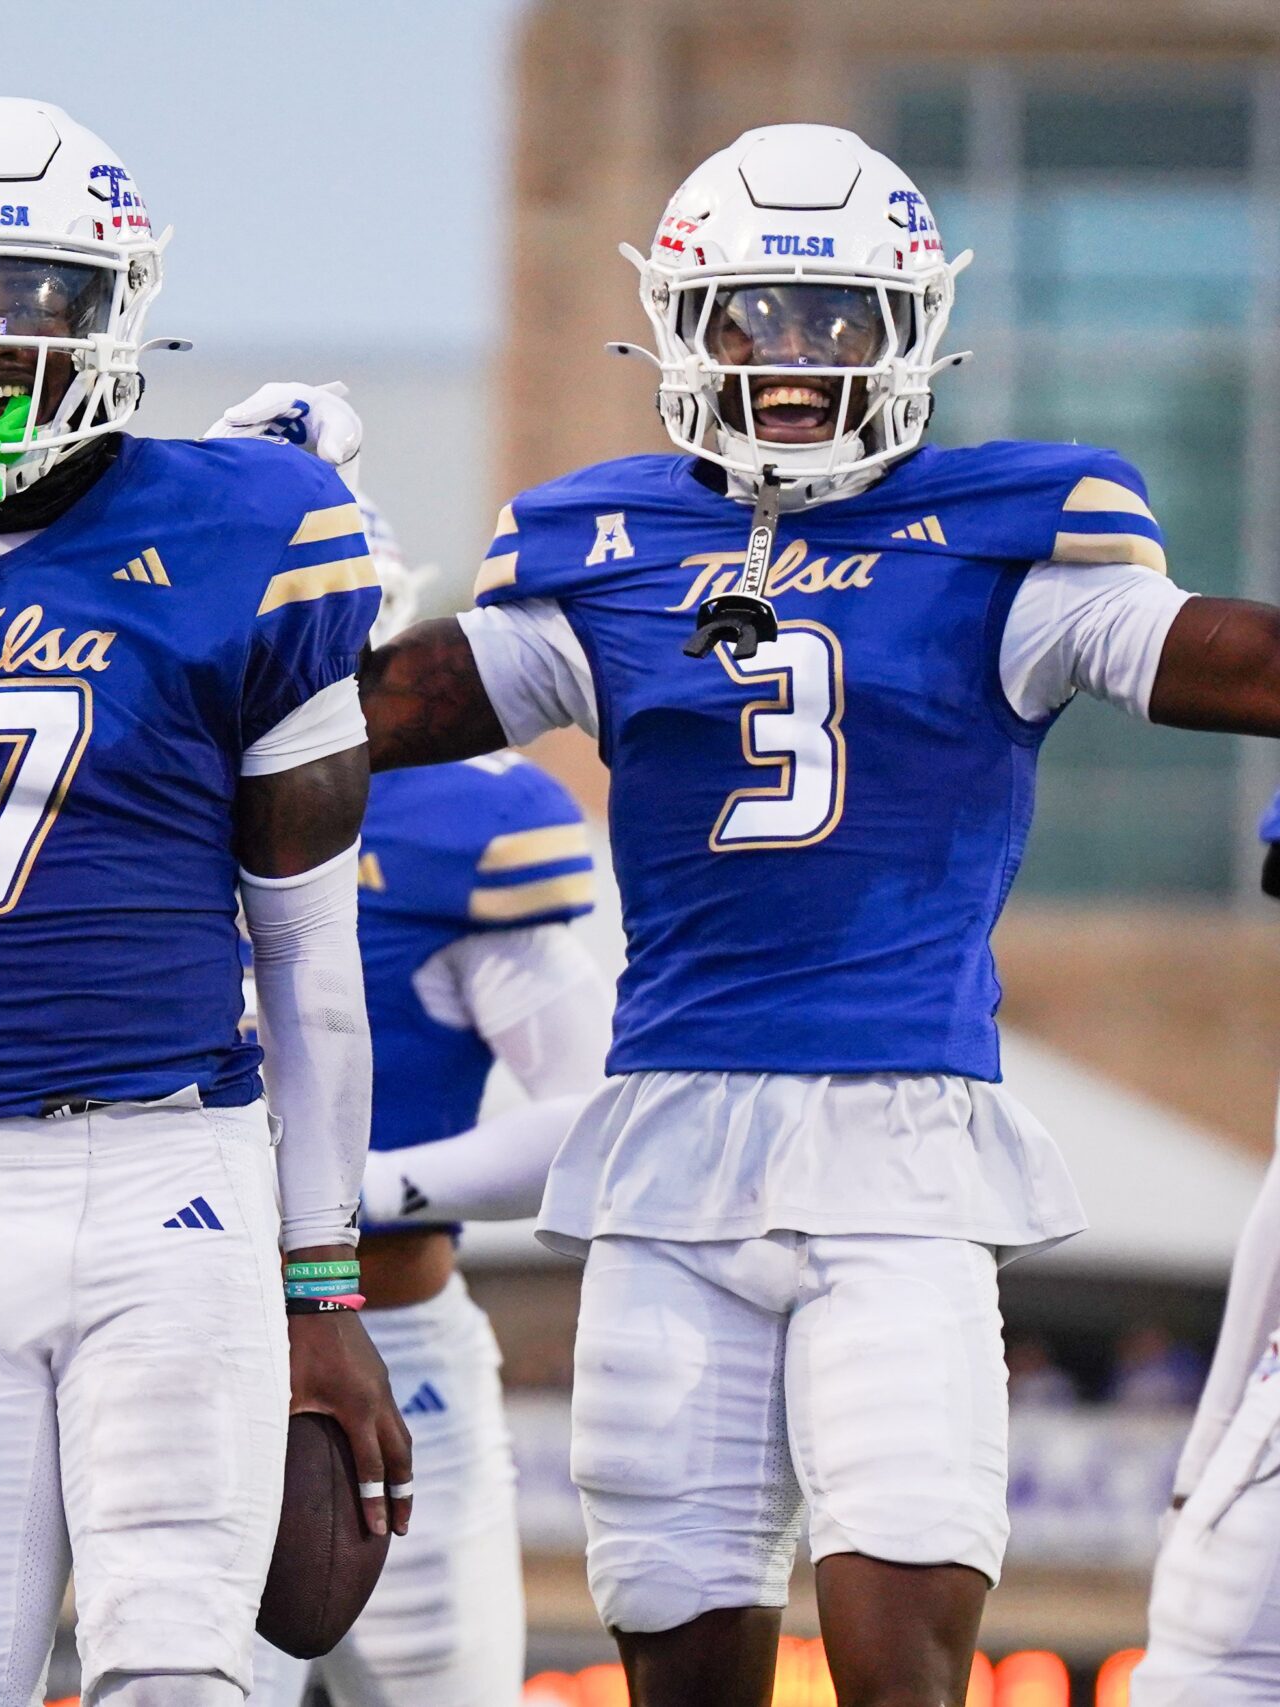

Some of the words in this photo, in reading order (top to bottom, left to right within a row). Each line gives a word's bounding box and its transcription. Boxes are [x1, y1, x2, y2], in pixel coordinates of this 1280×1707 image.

[761, 234, 835, 258] TULSA
[586, 512, 636, 567] A
[709, 619, 846, 853] 3
